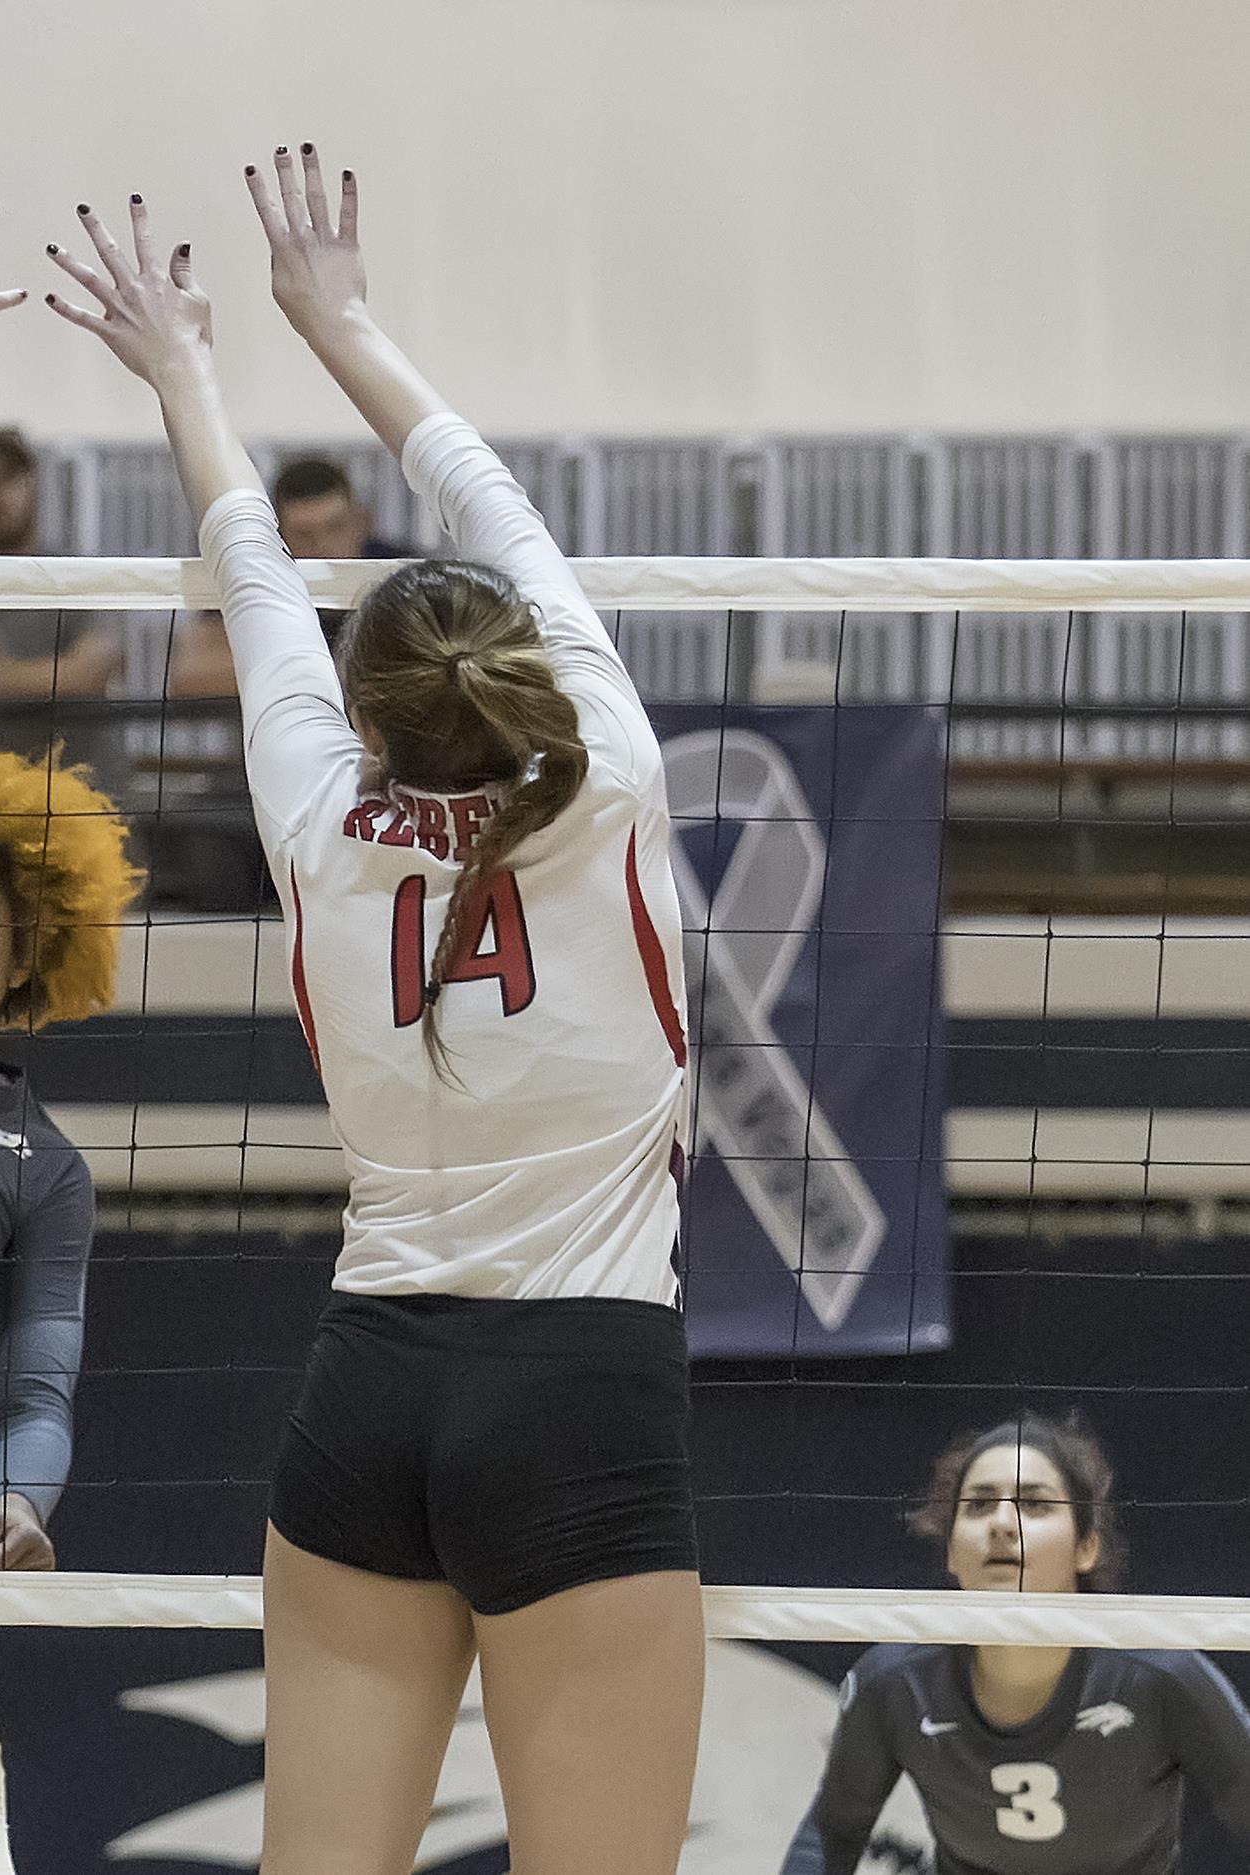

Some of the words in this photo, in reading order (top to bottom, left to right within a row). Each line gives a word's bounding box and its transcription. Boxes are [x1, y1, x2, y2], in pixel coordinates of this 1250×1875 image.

[343, 793, 499, 862] REBE
[390, 870, 536, 1028] 14
[990, 1762, 1067, 1842] 3
